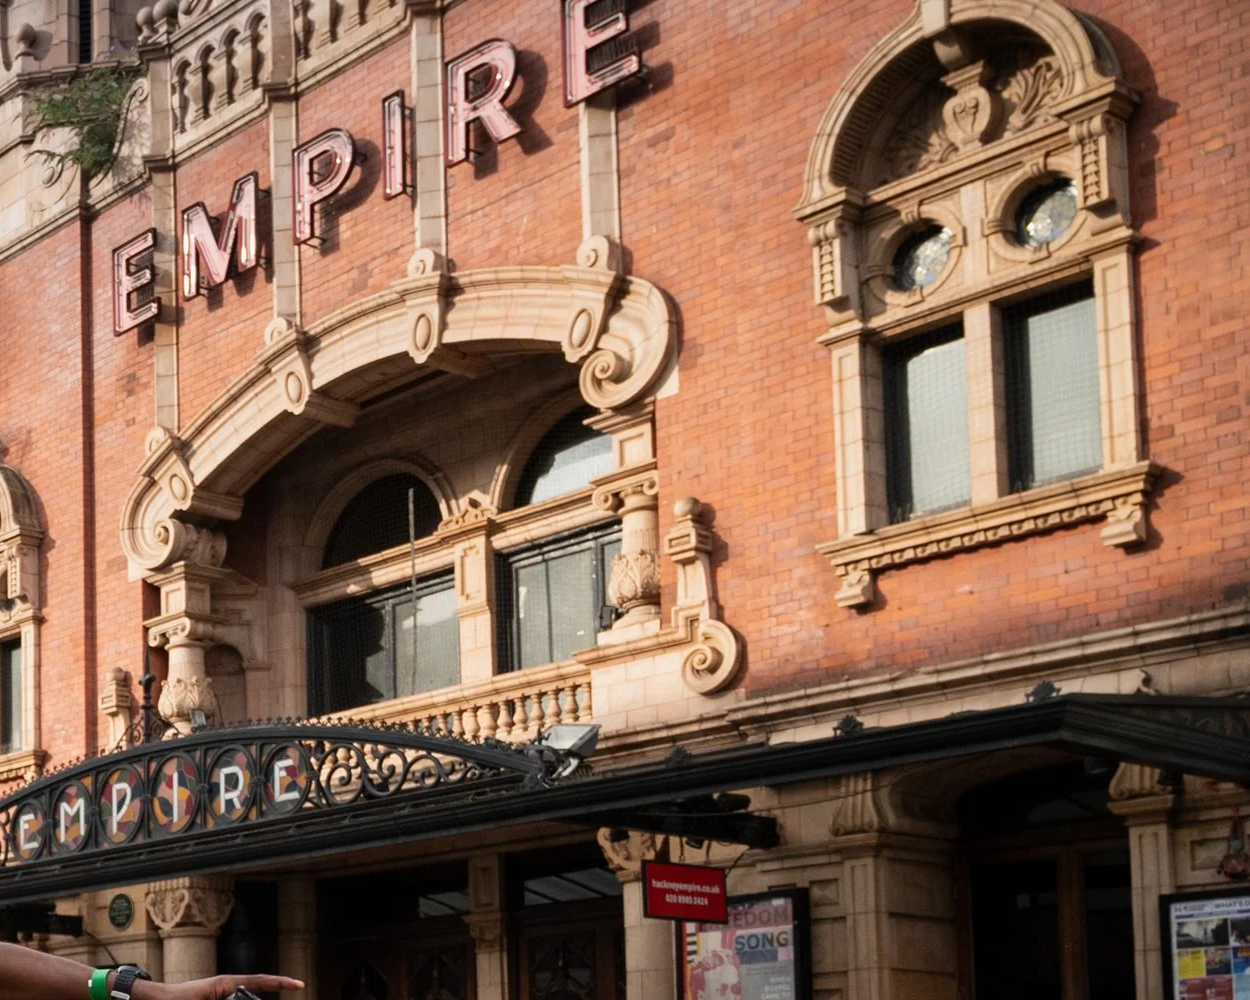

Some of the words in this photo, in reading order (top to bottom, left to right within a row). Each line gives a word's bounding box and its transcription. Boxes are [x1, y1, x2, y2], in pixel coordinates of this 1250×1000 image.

[111, 0, 642, 336] EMPIRE
[18, 758, 302, 851] EMPIRE
[735, 930, 789, 951] SONG
